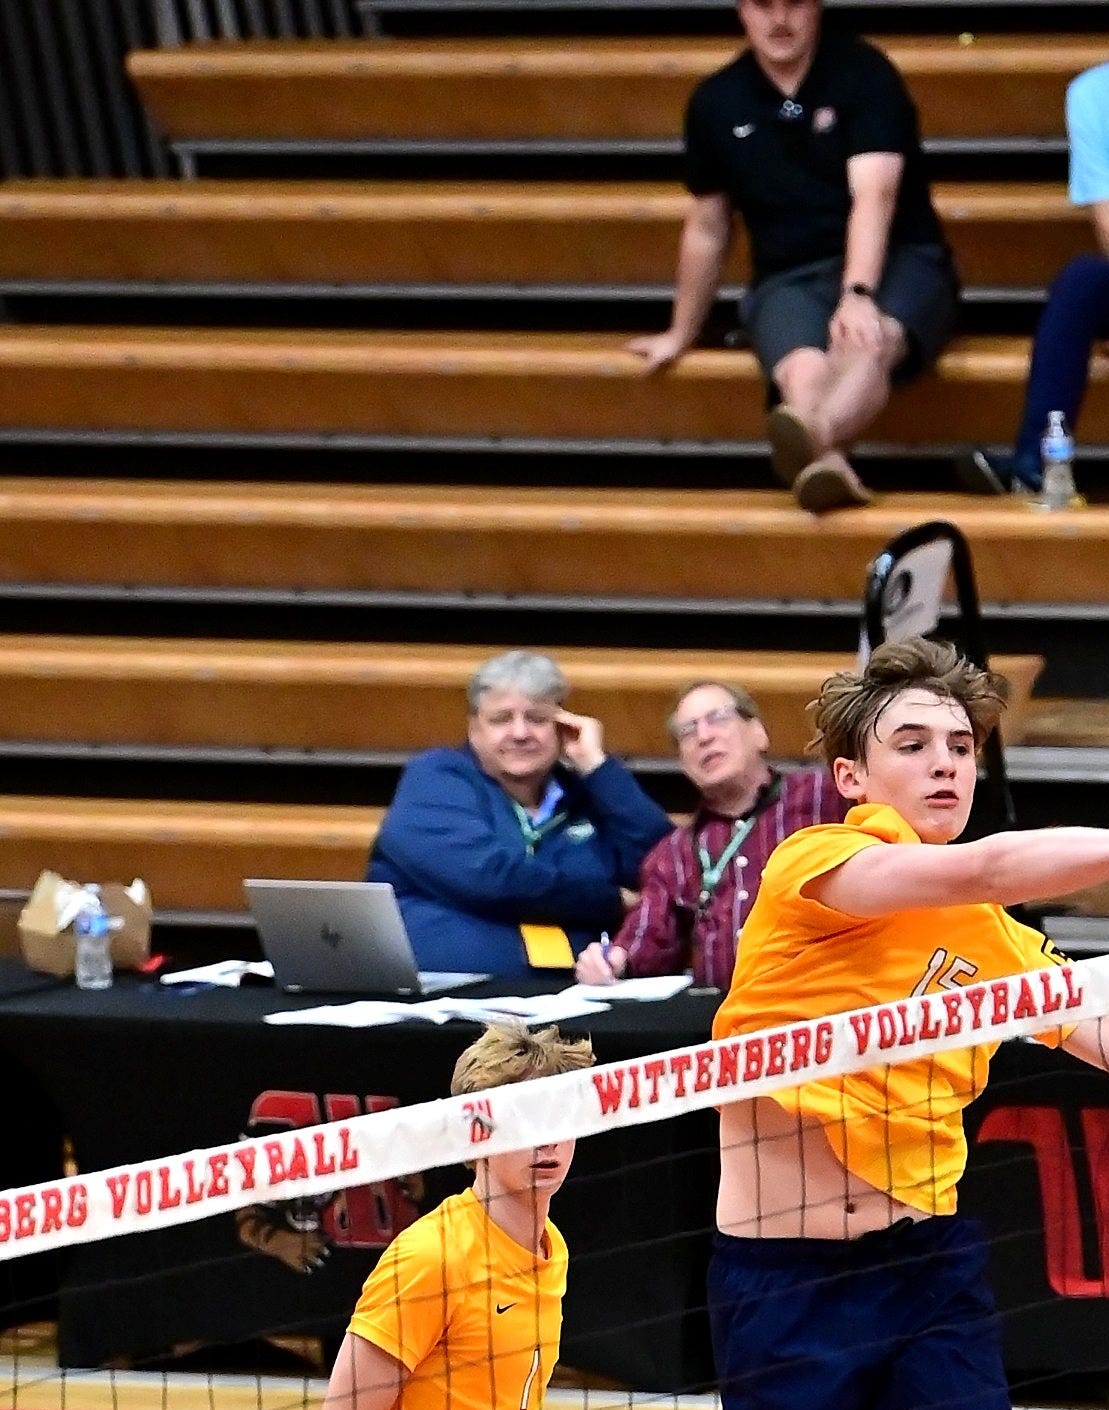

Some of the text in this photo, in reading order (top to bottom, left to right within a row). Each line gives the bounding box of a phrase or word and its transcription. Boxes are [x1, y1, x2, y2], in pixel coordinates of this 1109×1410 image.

[592, 965, 1084, 1116] WITTENBERG VOLLEYBALL
[105, 1128, 359, 1219] VOLLEYBALL
